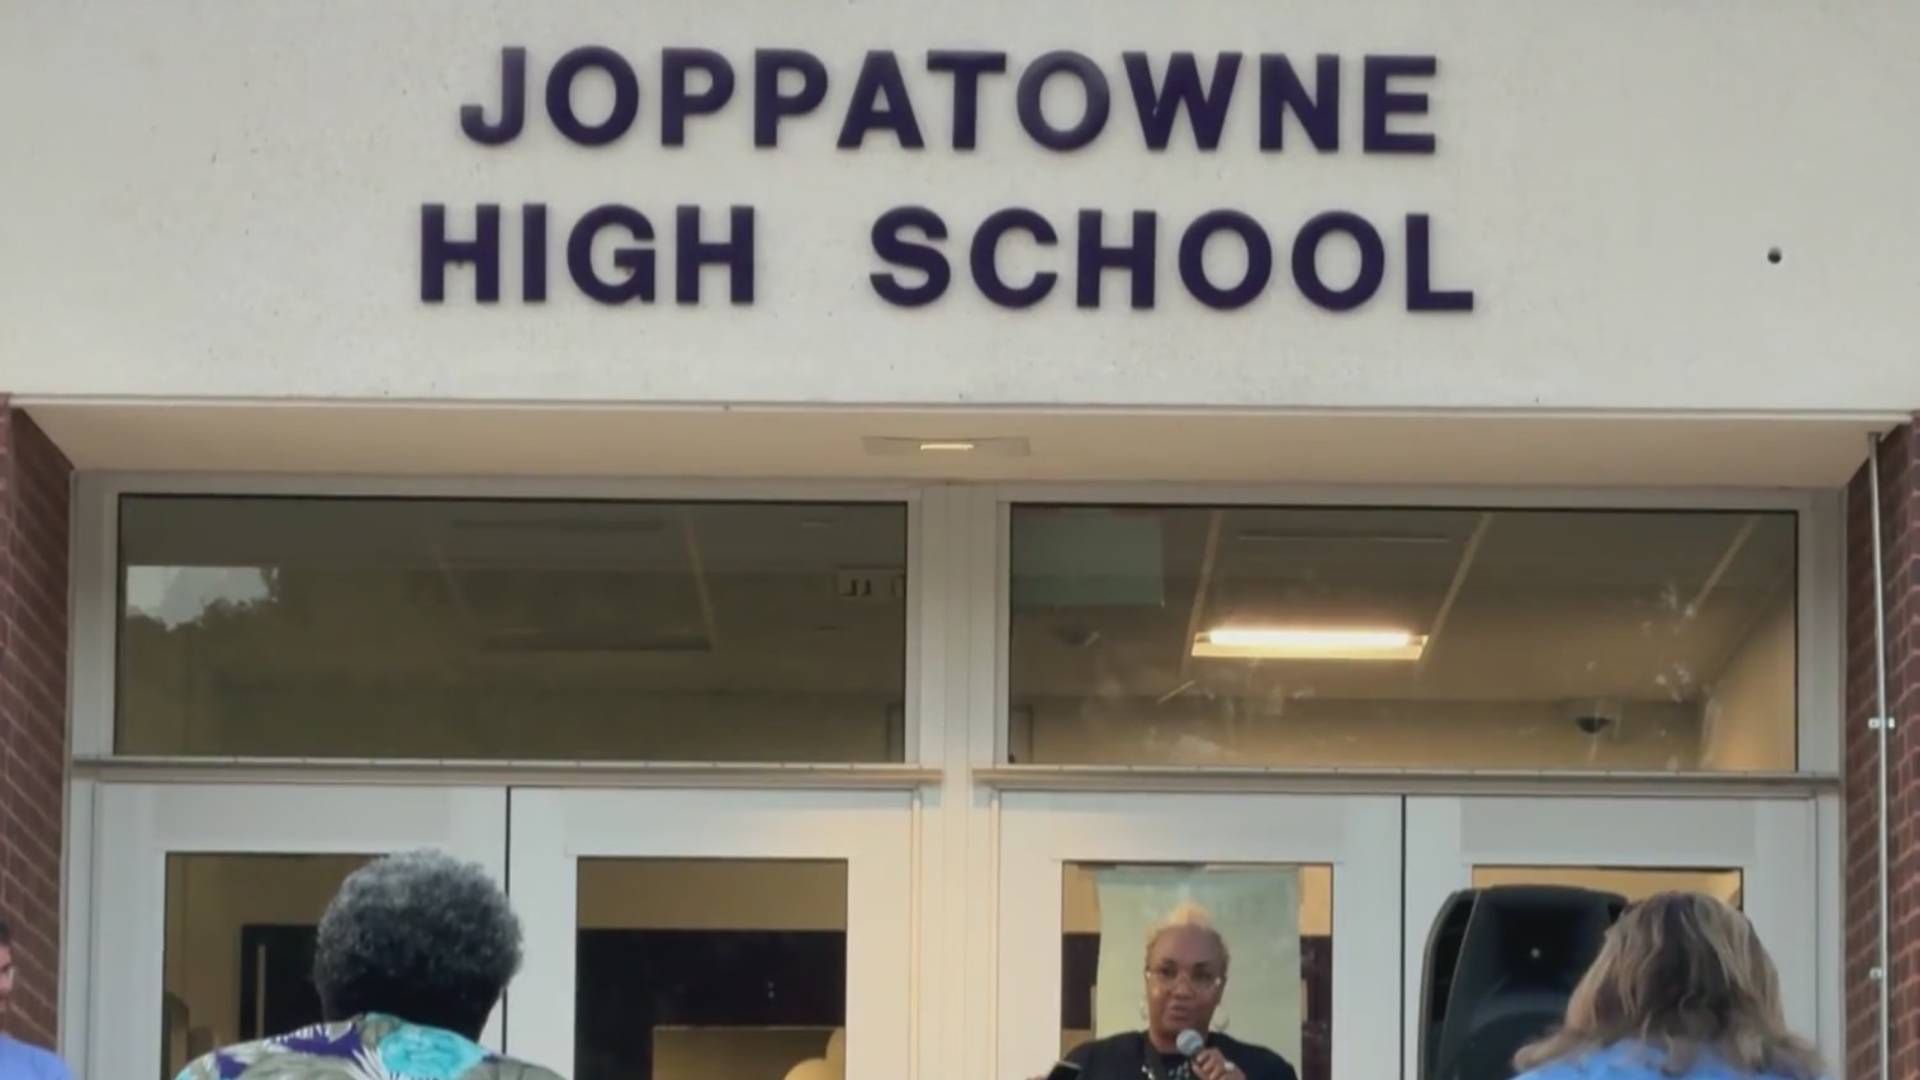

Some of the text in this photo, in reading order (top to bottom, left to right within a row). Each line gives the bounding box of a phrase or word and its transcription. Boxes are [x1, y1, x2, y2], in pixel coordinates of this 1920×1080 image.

[460, 45, 1438, 156] JOPPATOWNE
[420, 203, 1475, 314] HIGH SCHOOL
